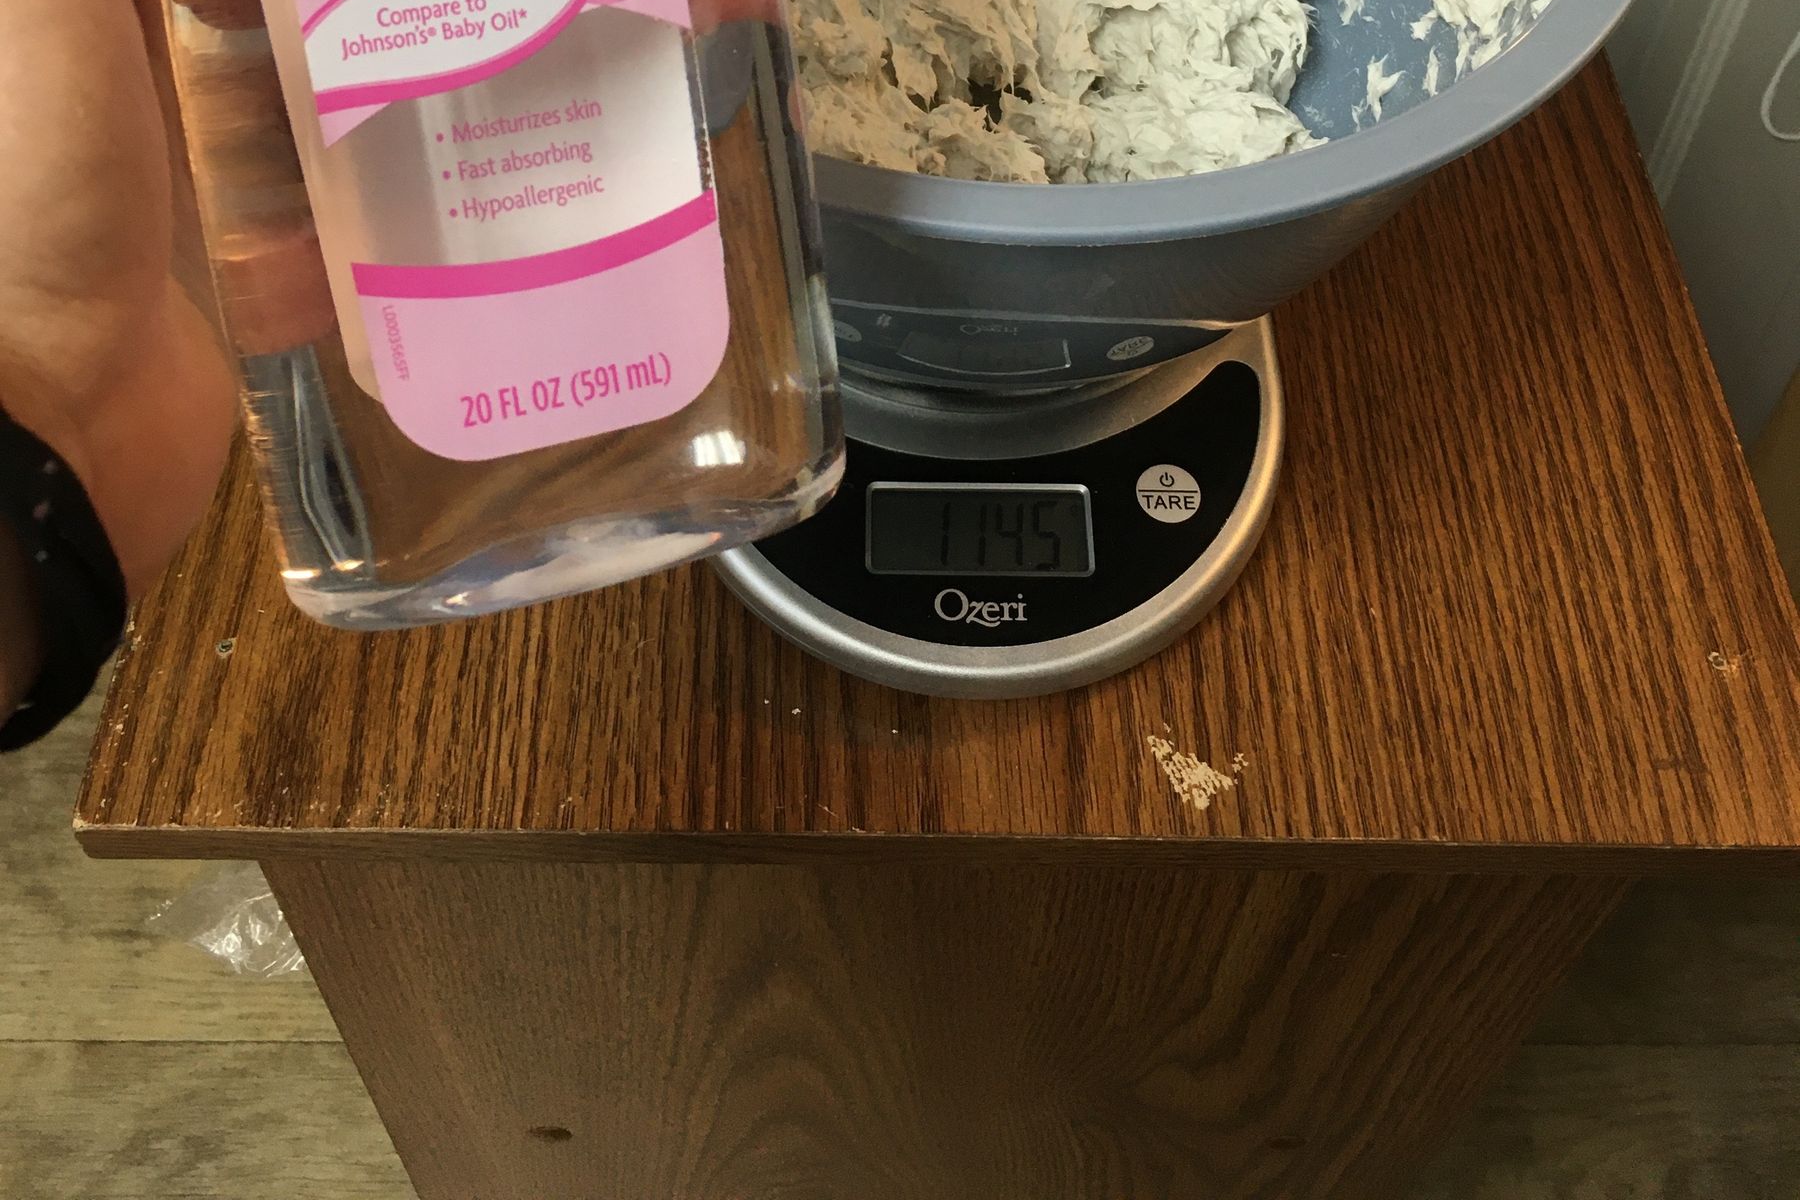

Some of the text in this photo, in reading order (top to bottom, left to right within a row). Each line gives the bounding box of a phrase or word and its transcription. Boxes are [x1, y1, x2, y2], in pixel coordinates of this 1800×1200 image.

[377, 0, 461, 27] Compare
[442, 18, 485, 39] Baby
[452, 100, 602, 143] Moisturizes skin
[458, 142, 593, 181] Fast absorbing
[462, 175, 605, 222] Hypoallergenic
[460, 352, 672, 428] 20 FL OZ (591 mL)
[1141, 494, 1196, 511] TARE
[940, 501, 1061, 570] 1145
[934, 588, 1028, 627] Ozeri
